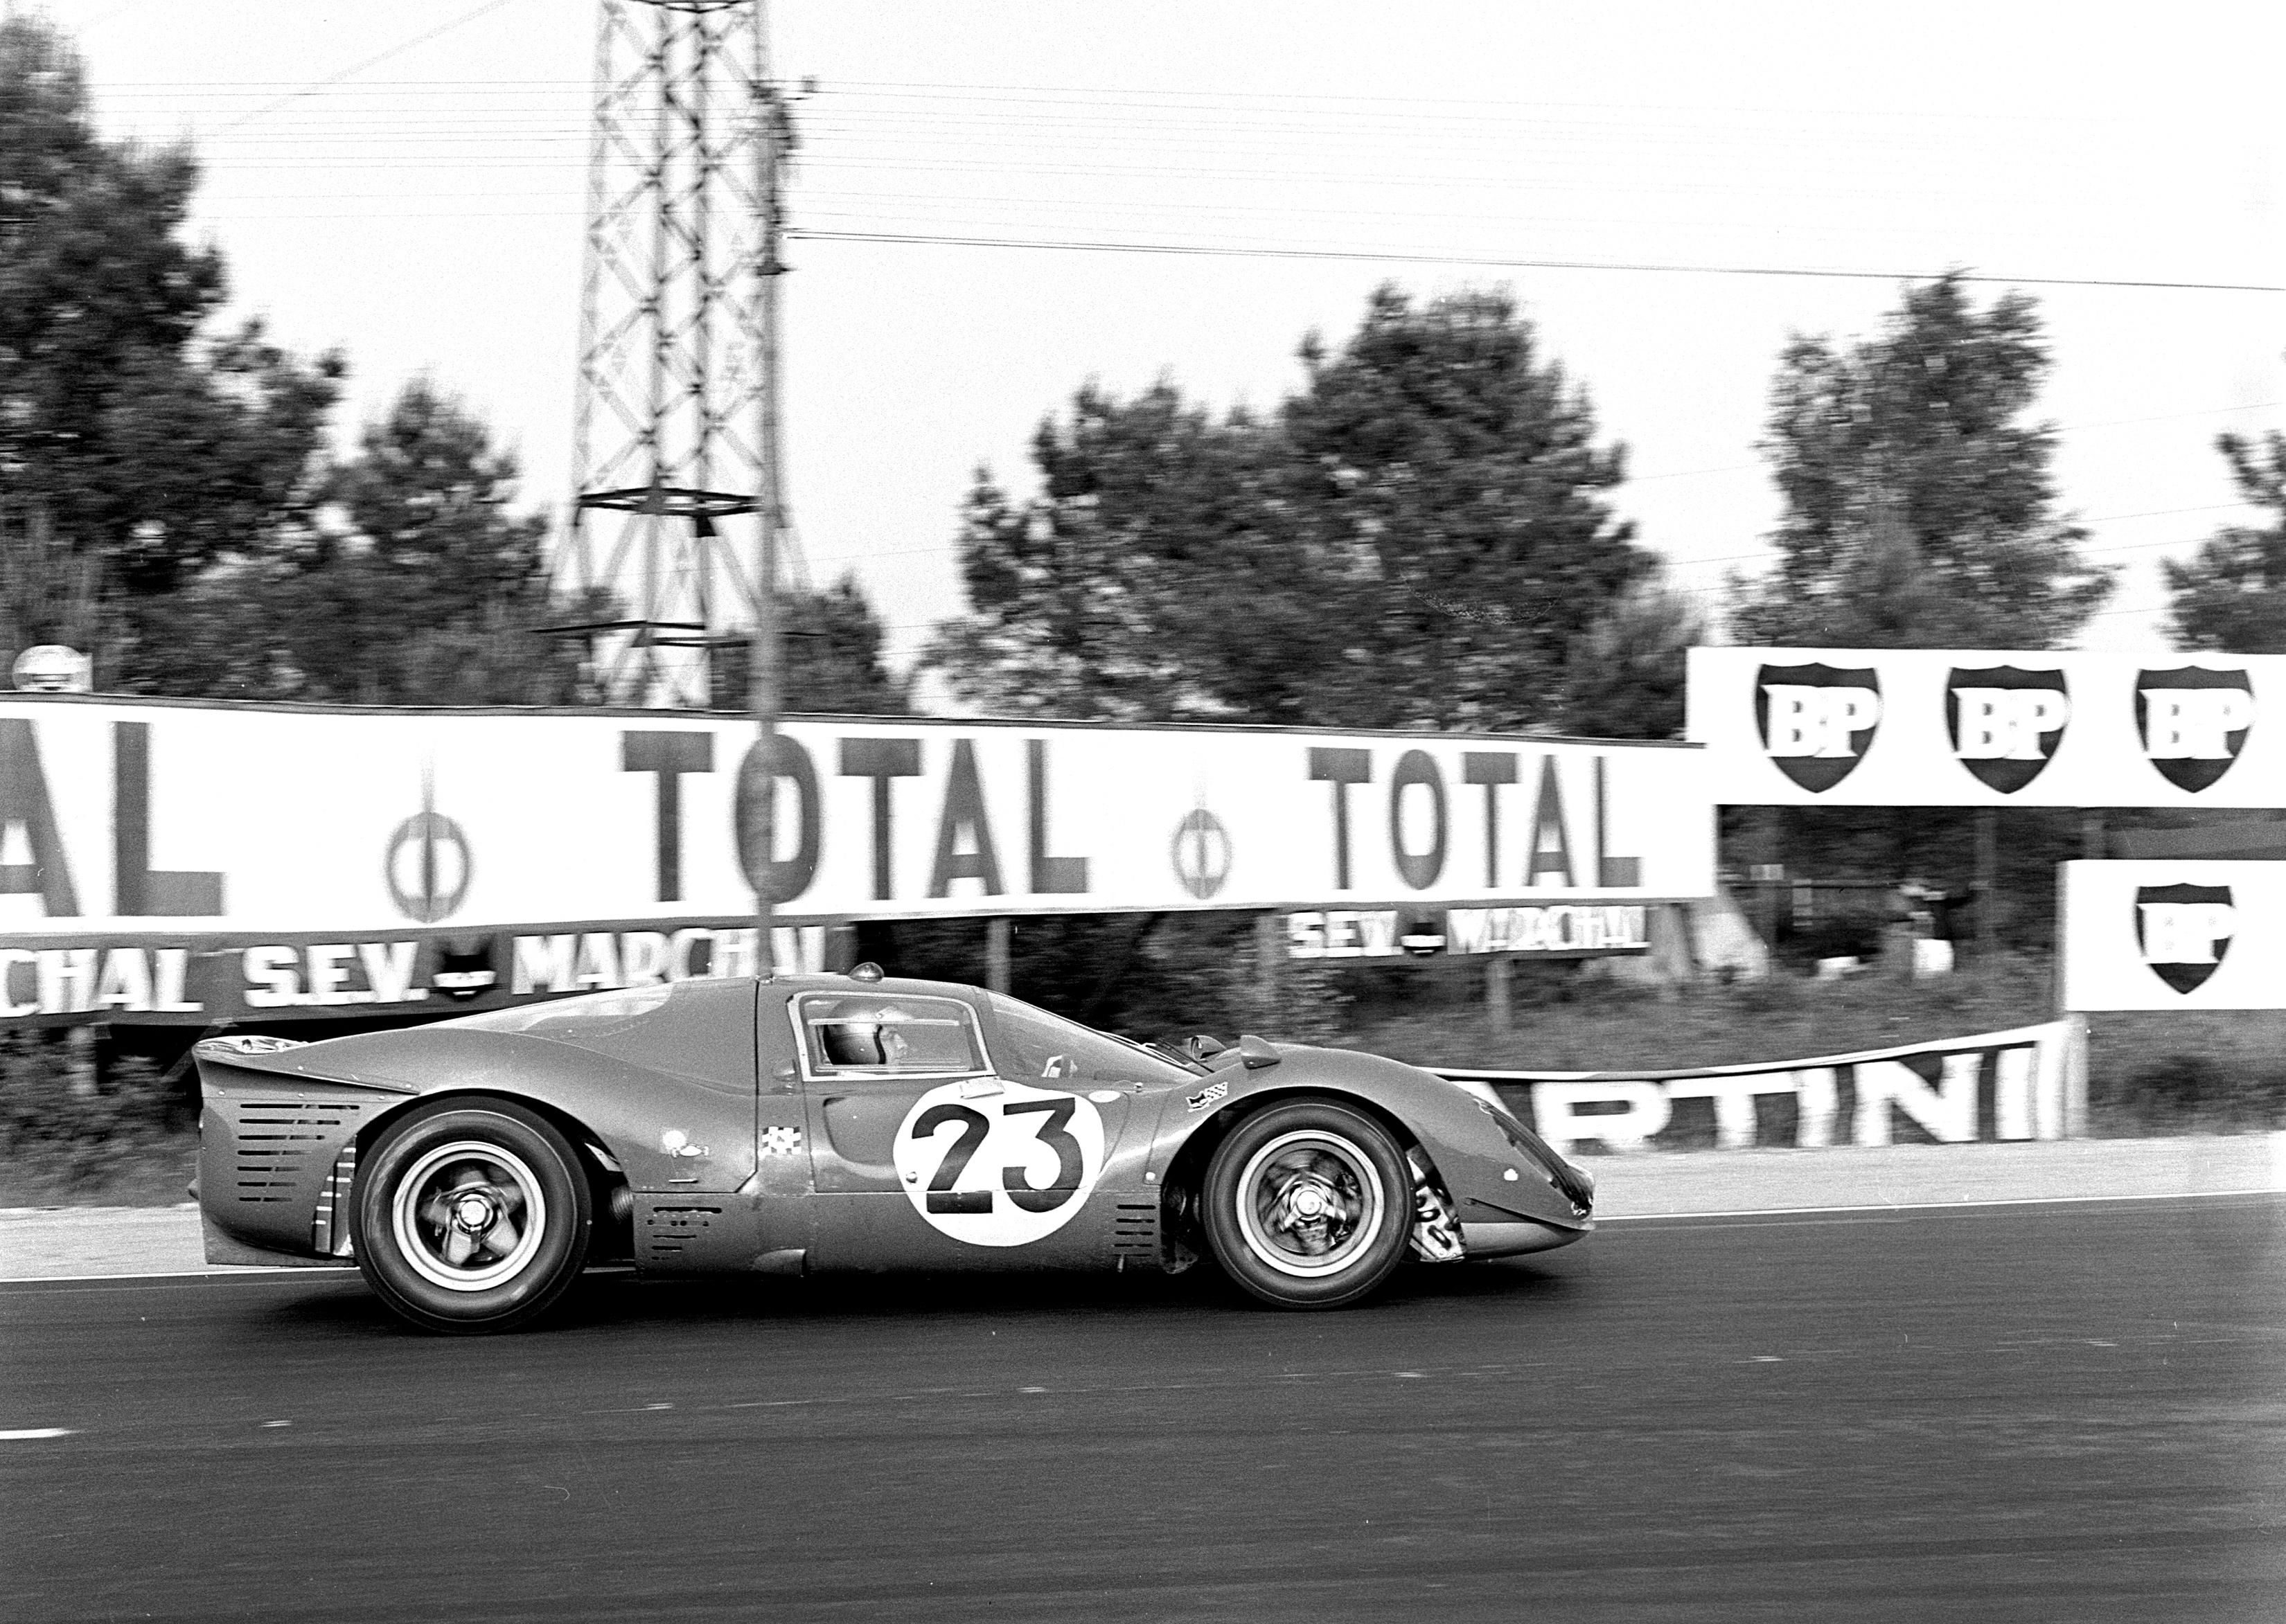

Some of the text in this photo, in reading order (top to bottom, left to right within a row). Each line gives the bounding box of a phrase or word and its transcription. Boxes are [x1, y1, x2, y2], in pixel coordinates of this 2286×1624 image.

[1761, 683, 1879, 758] BP
[1950, 687, 2070, 760] BP
[2136, 688, 2254, 759] BP
[621, 731, 1090, 905] TOTAL
[1308, 747, 1642, 891] TOTAL
[2136, 902, 2236, 964] BP
[912, 1097, 1083, 1213] 23
